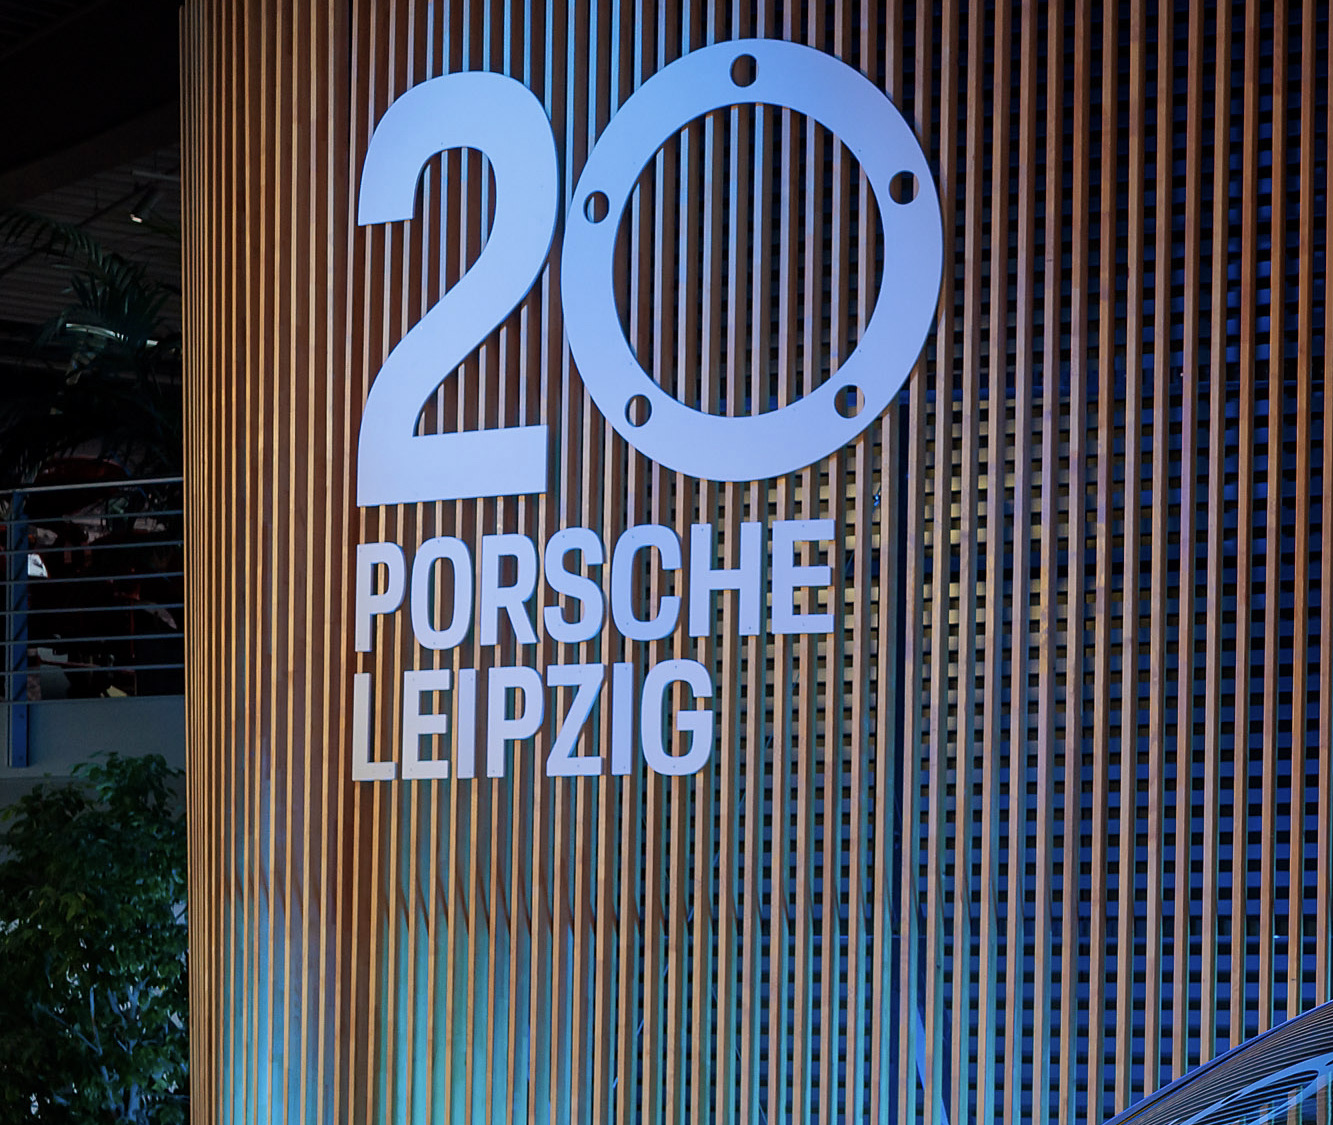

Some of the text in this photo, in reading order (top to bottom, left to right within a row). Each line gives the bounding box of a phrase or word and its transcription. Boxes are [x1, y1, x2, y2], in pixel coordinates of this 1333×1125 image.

[357, 38, 943, 506] 20
[355, 519, 836, 652] PORSCHE
[352, 658, 714, 781] LEIPZIG
